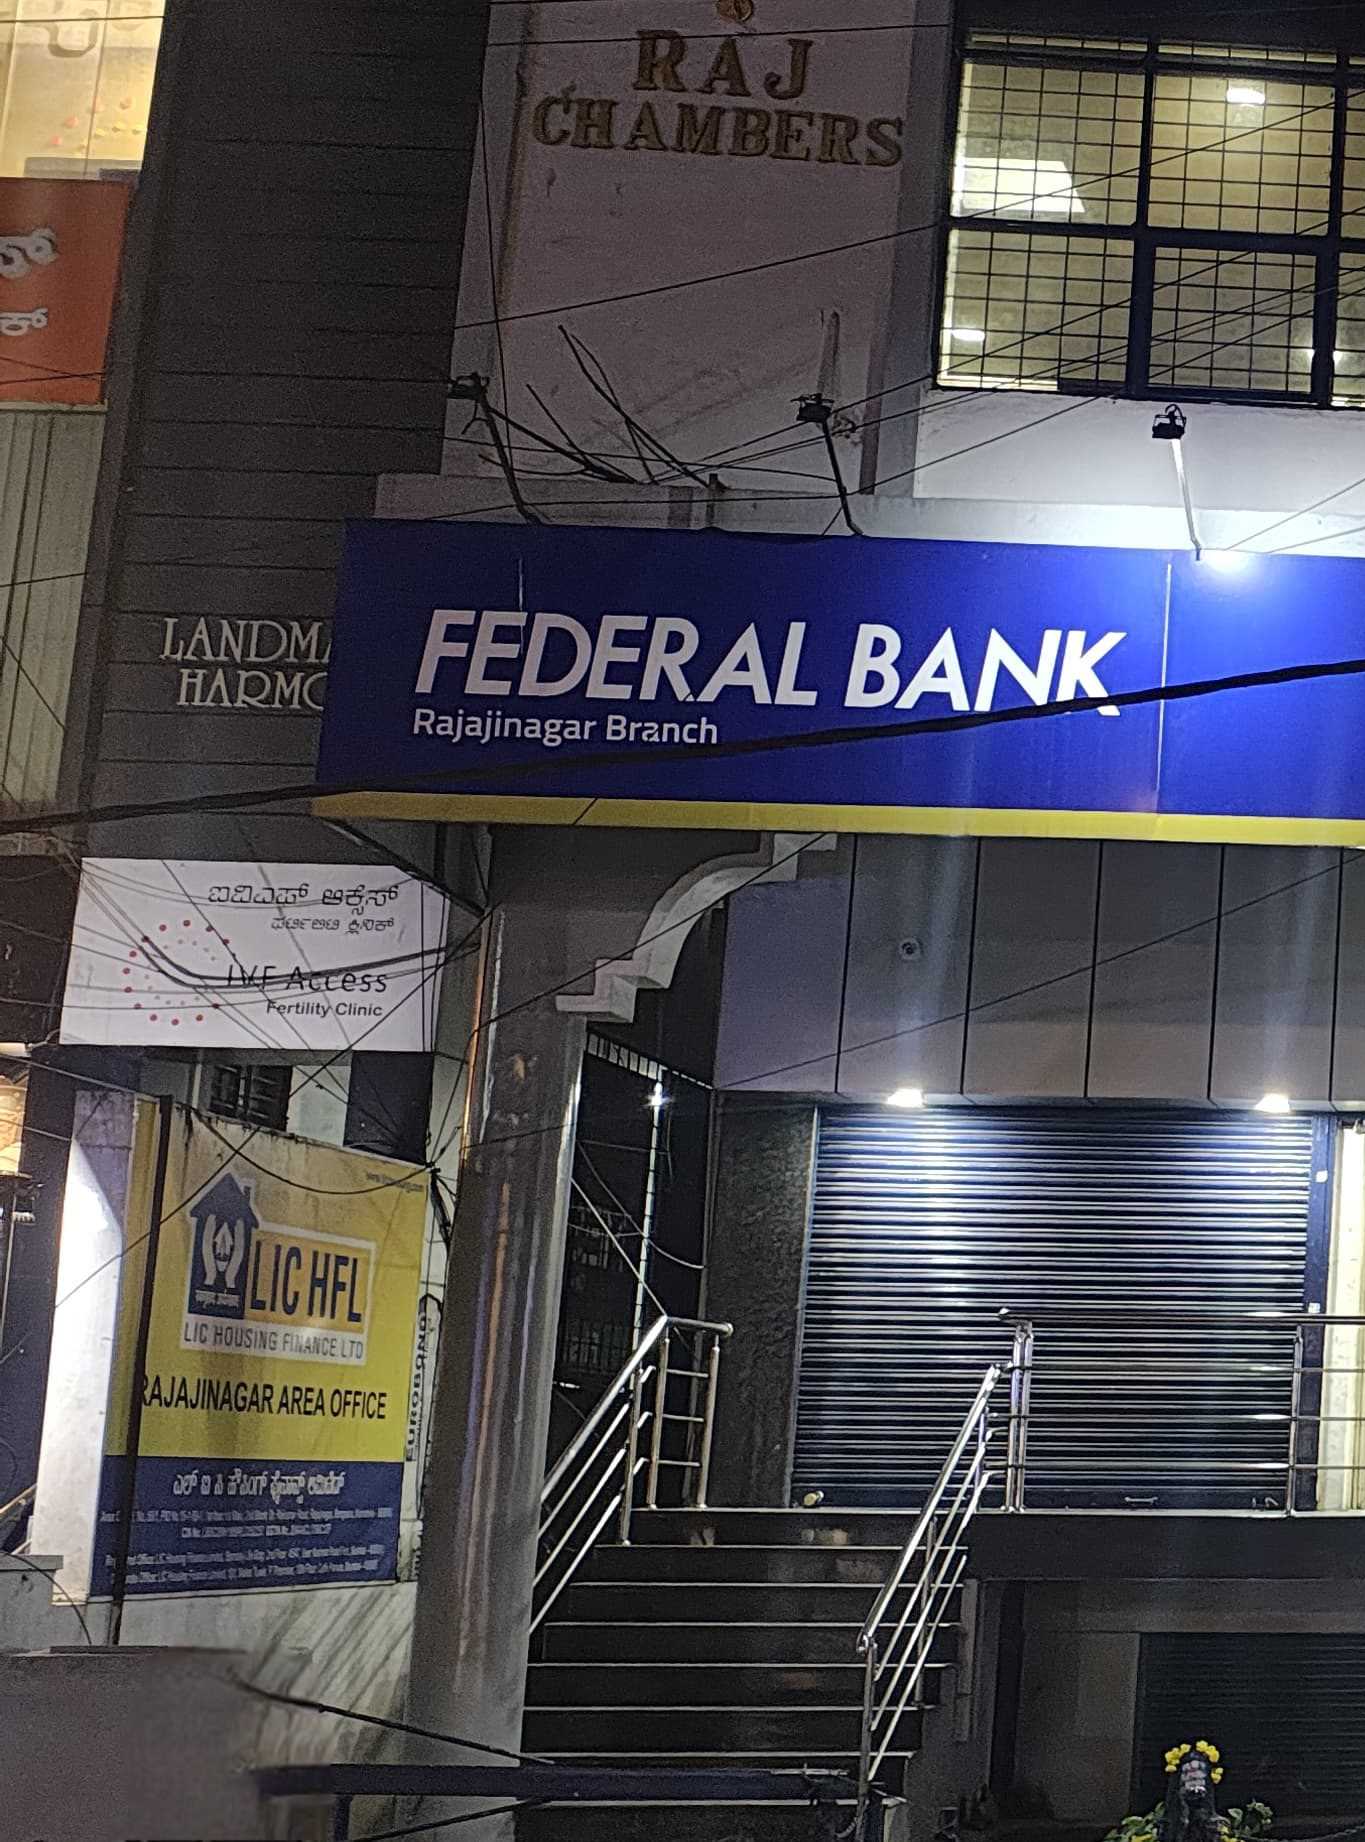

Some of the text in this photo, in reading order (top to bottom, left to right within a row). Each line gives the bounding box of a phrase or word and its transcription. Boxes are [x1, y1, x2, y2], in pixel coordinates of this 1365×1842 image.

[632, 29, 814, 100] RAJ
[533, 96, 902, 167] CHAMBERS
[160, 617, 332, 664] LANDM
[414, 609, 1127, 716] FEDERAL BANK
[413, 708, 718, 747] Rajajinagar Branch
[286, 965, 388, 993] Access
[267, 1001, 383, 1018] Fertility Clinic
[250, 1240, 363, 1323] LIC HFL
[183, 1321, 209, 1343] LIC
[212, 1325, 277, 1351] HOUSING
[282, 1333, 337, 1357] FINANCE
[277, 1386, 326, 1417] AREA
[330, 1388, 387, 1420] OFFICE
